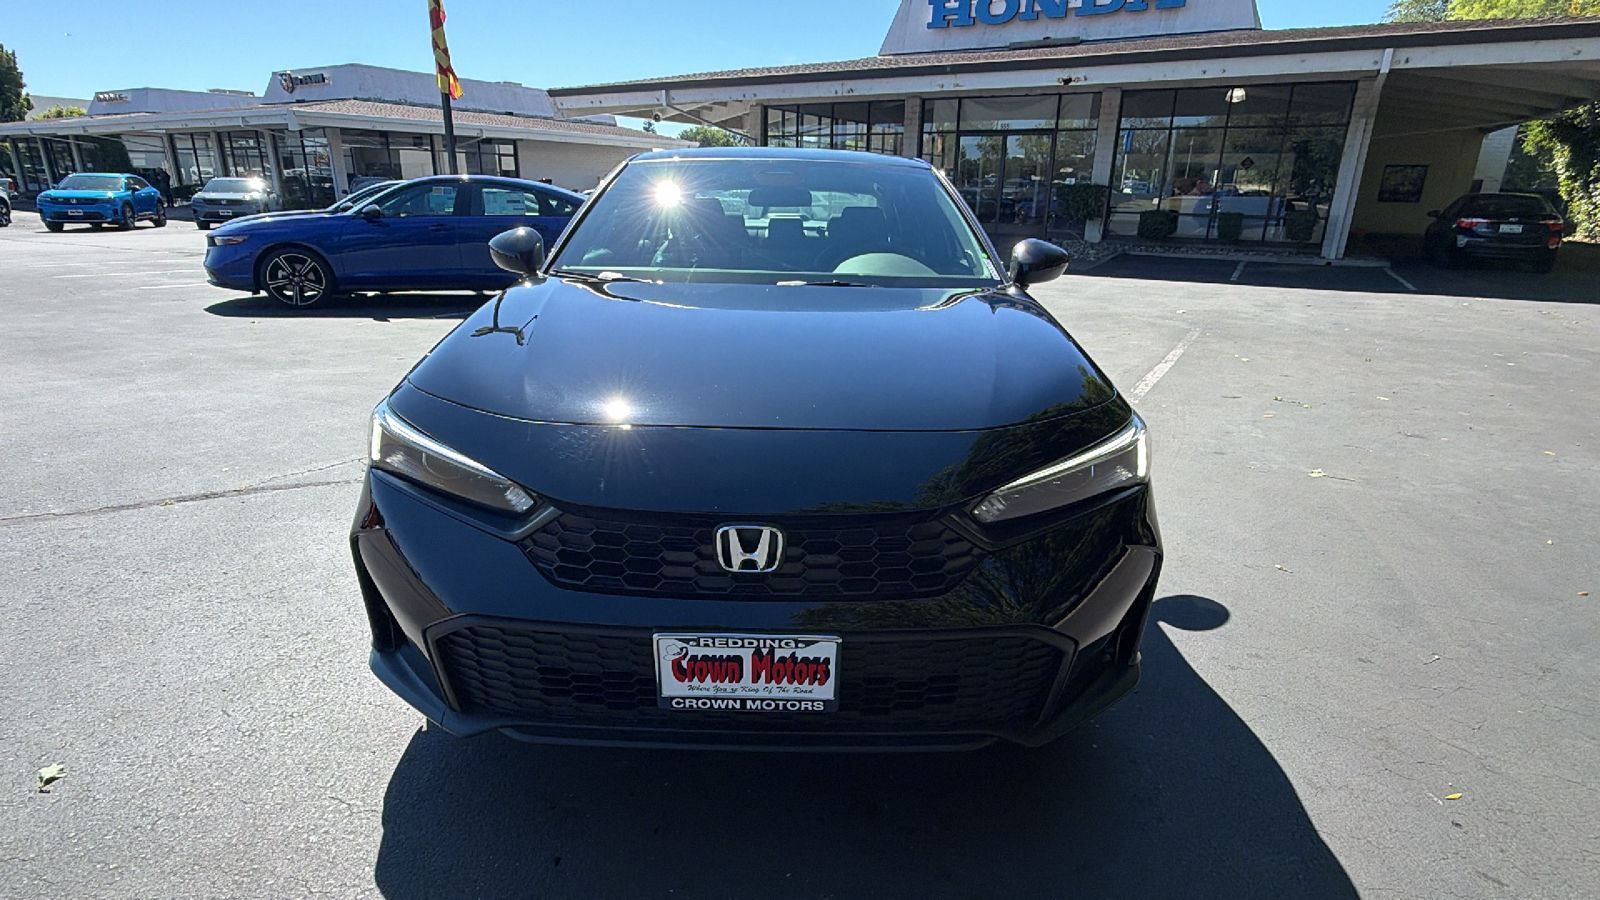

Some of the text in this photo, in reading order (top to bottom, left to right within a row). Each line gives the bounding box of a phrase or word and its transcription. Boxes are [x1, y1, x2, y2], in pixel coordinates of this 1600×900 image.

[926, 0, 1187, 29] HON
[699, 638, 796, 648] REDDING
[671, 647, 831, 686] Crown Motors
[687, 684, 711, 692] Where
[740, 686, 760, 694] King
[762, 686, 774, 694] Of
[671, 698, 825, 711] CROWN MOTORS
